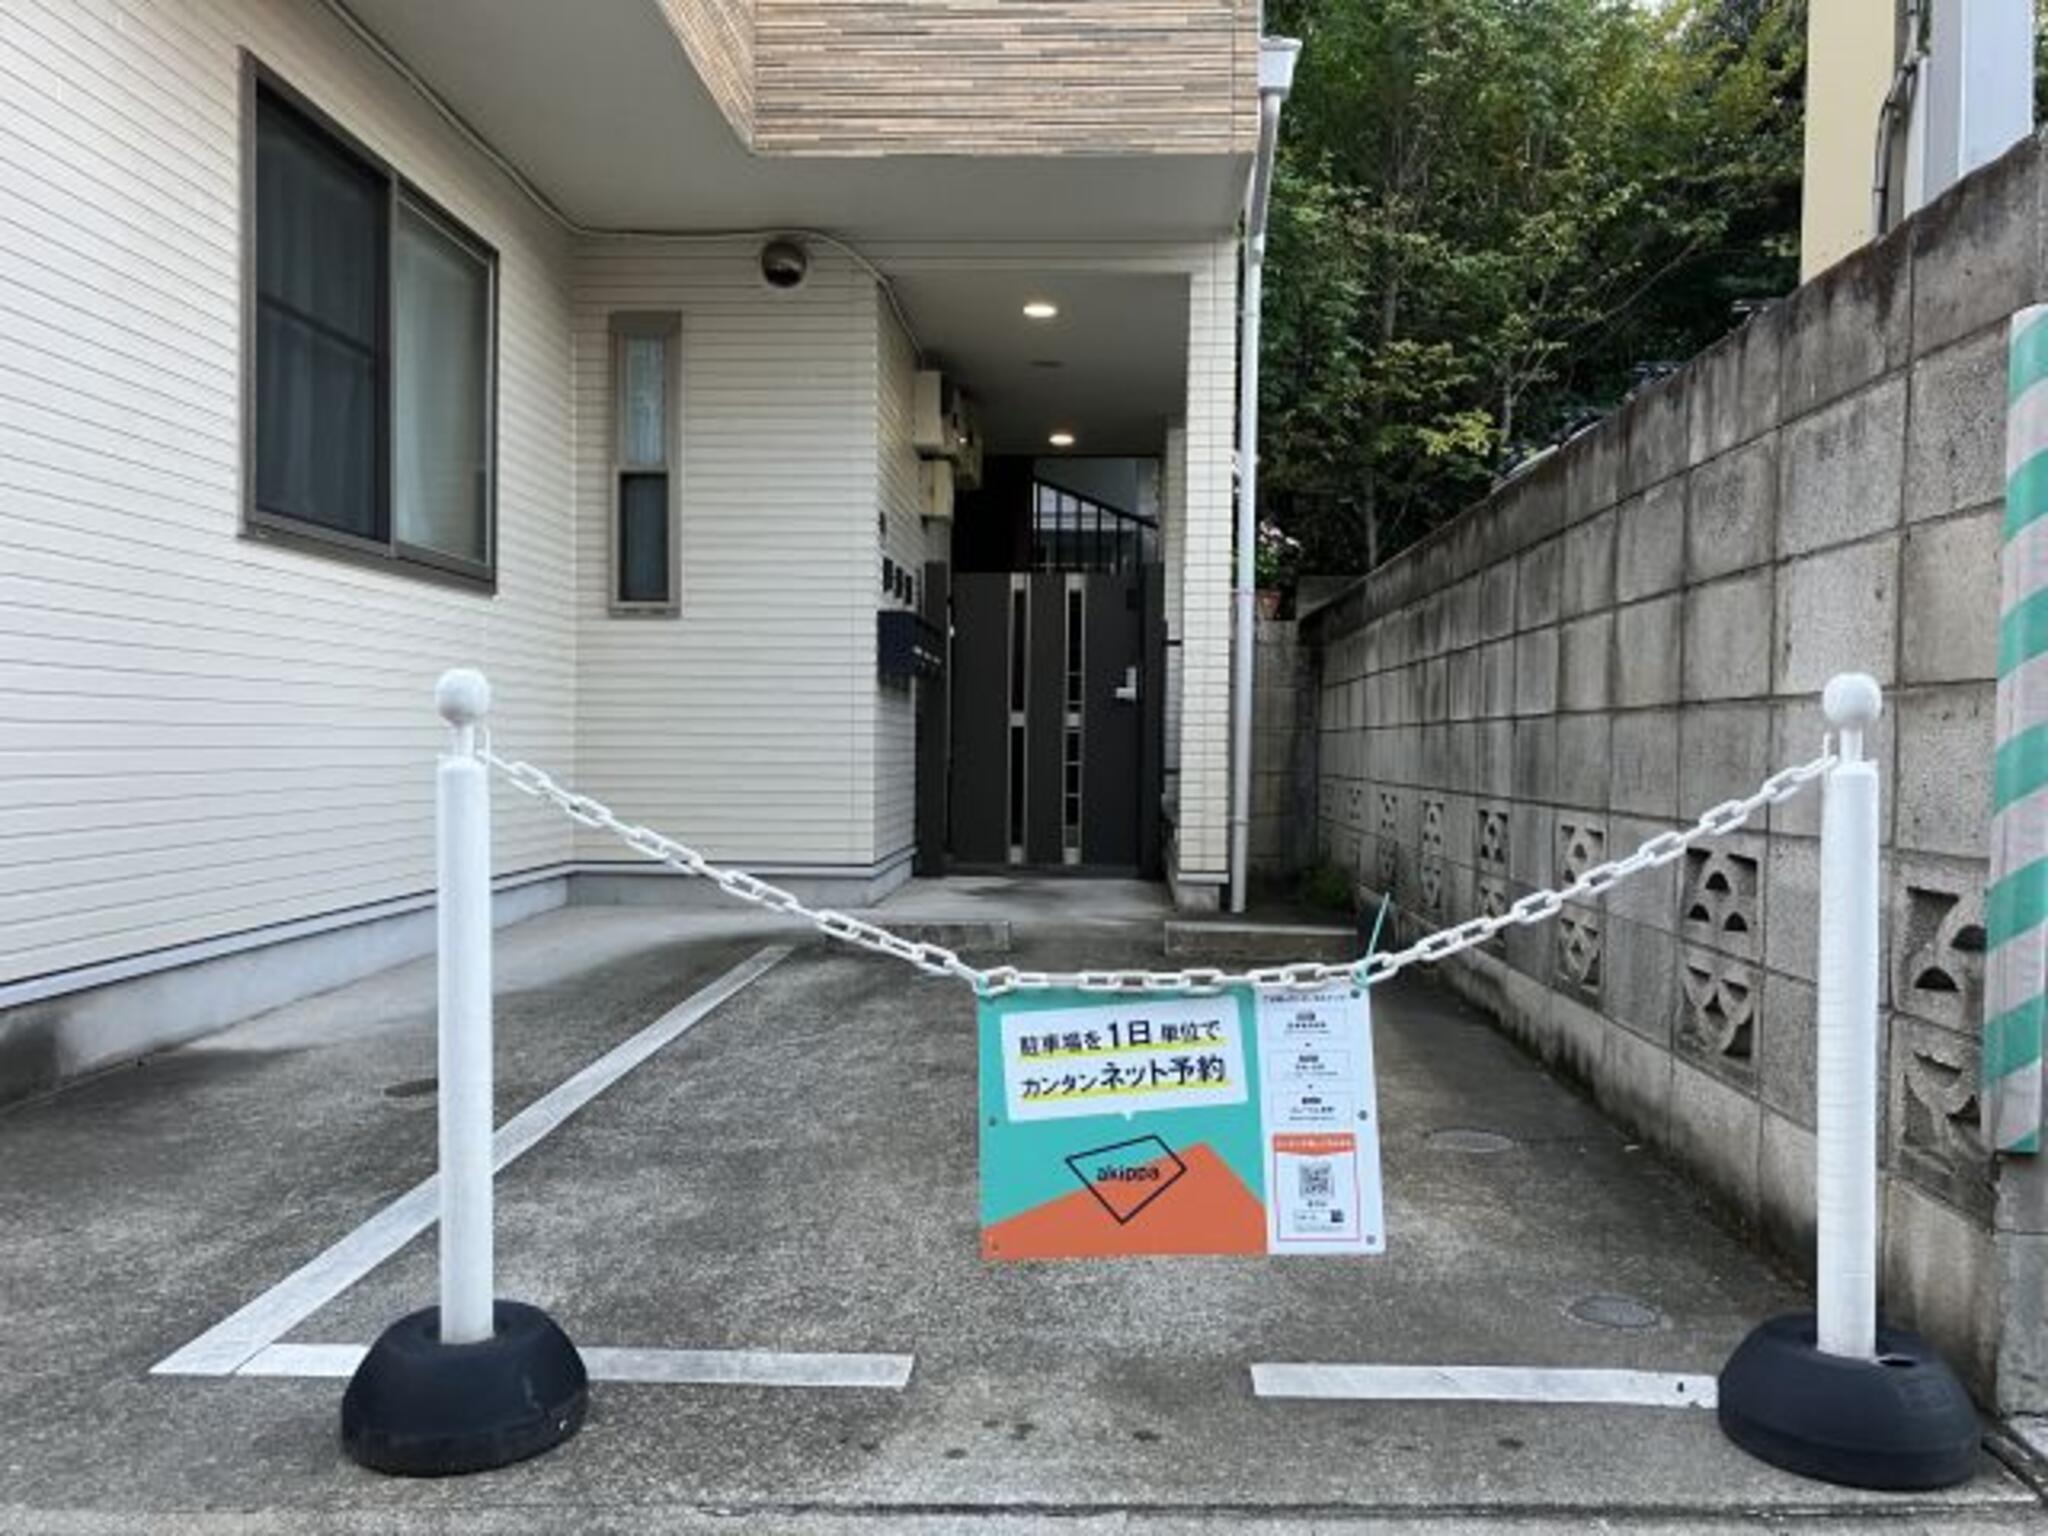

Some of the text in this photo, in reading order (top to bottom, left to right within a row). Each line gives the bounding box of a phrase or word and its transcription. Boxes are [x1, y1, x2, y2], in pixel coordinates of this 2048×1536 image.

[1021, 1053, 1226, 1099] カンタンネット予約
[1097, 1164, 1159, 1183] akippa
